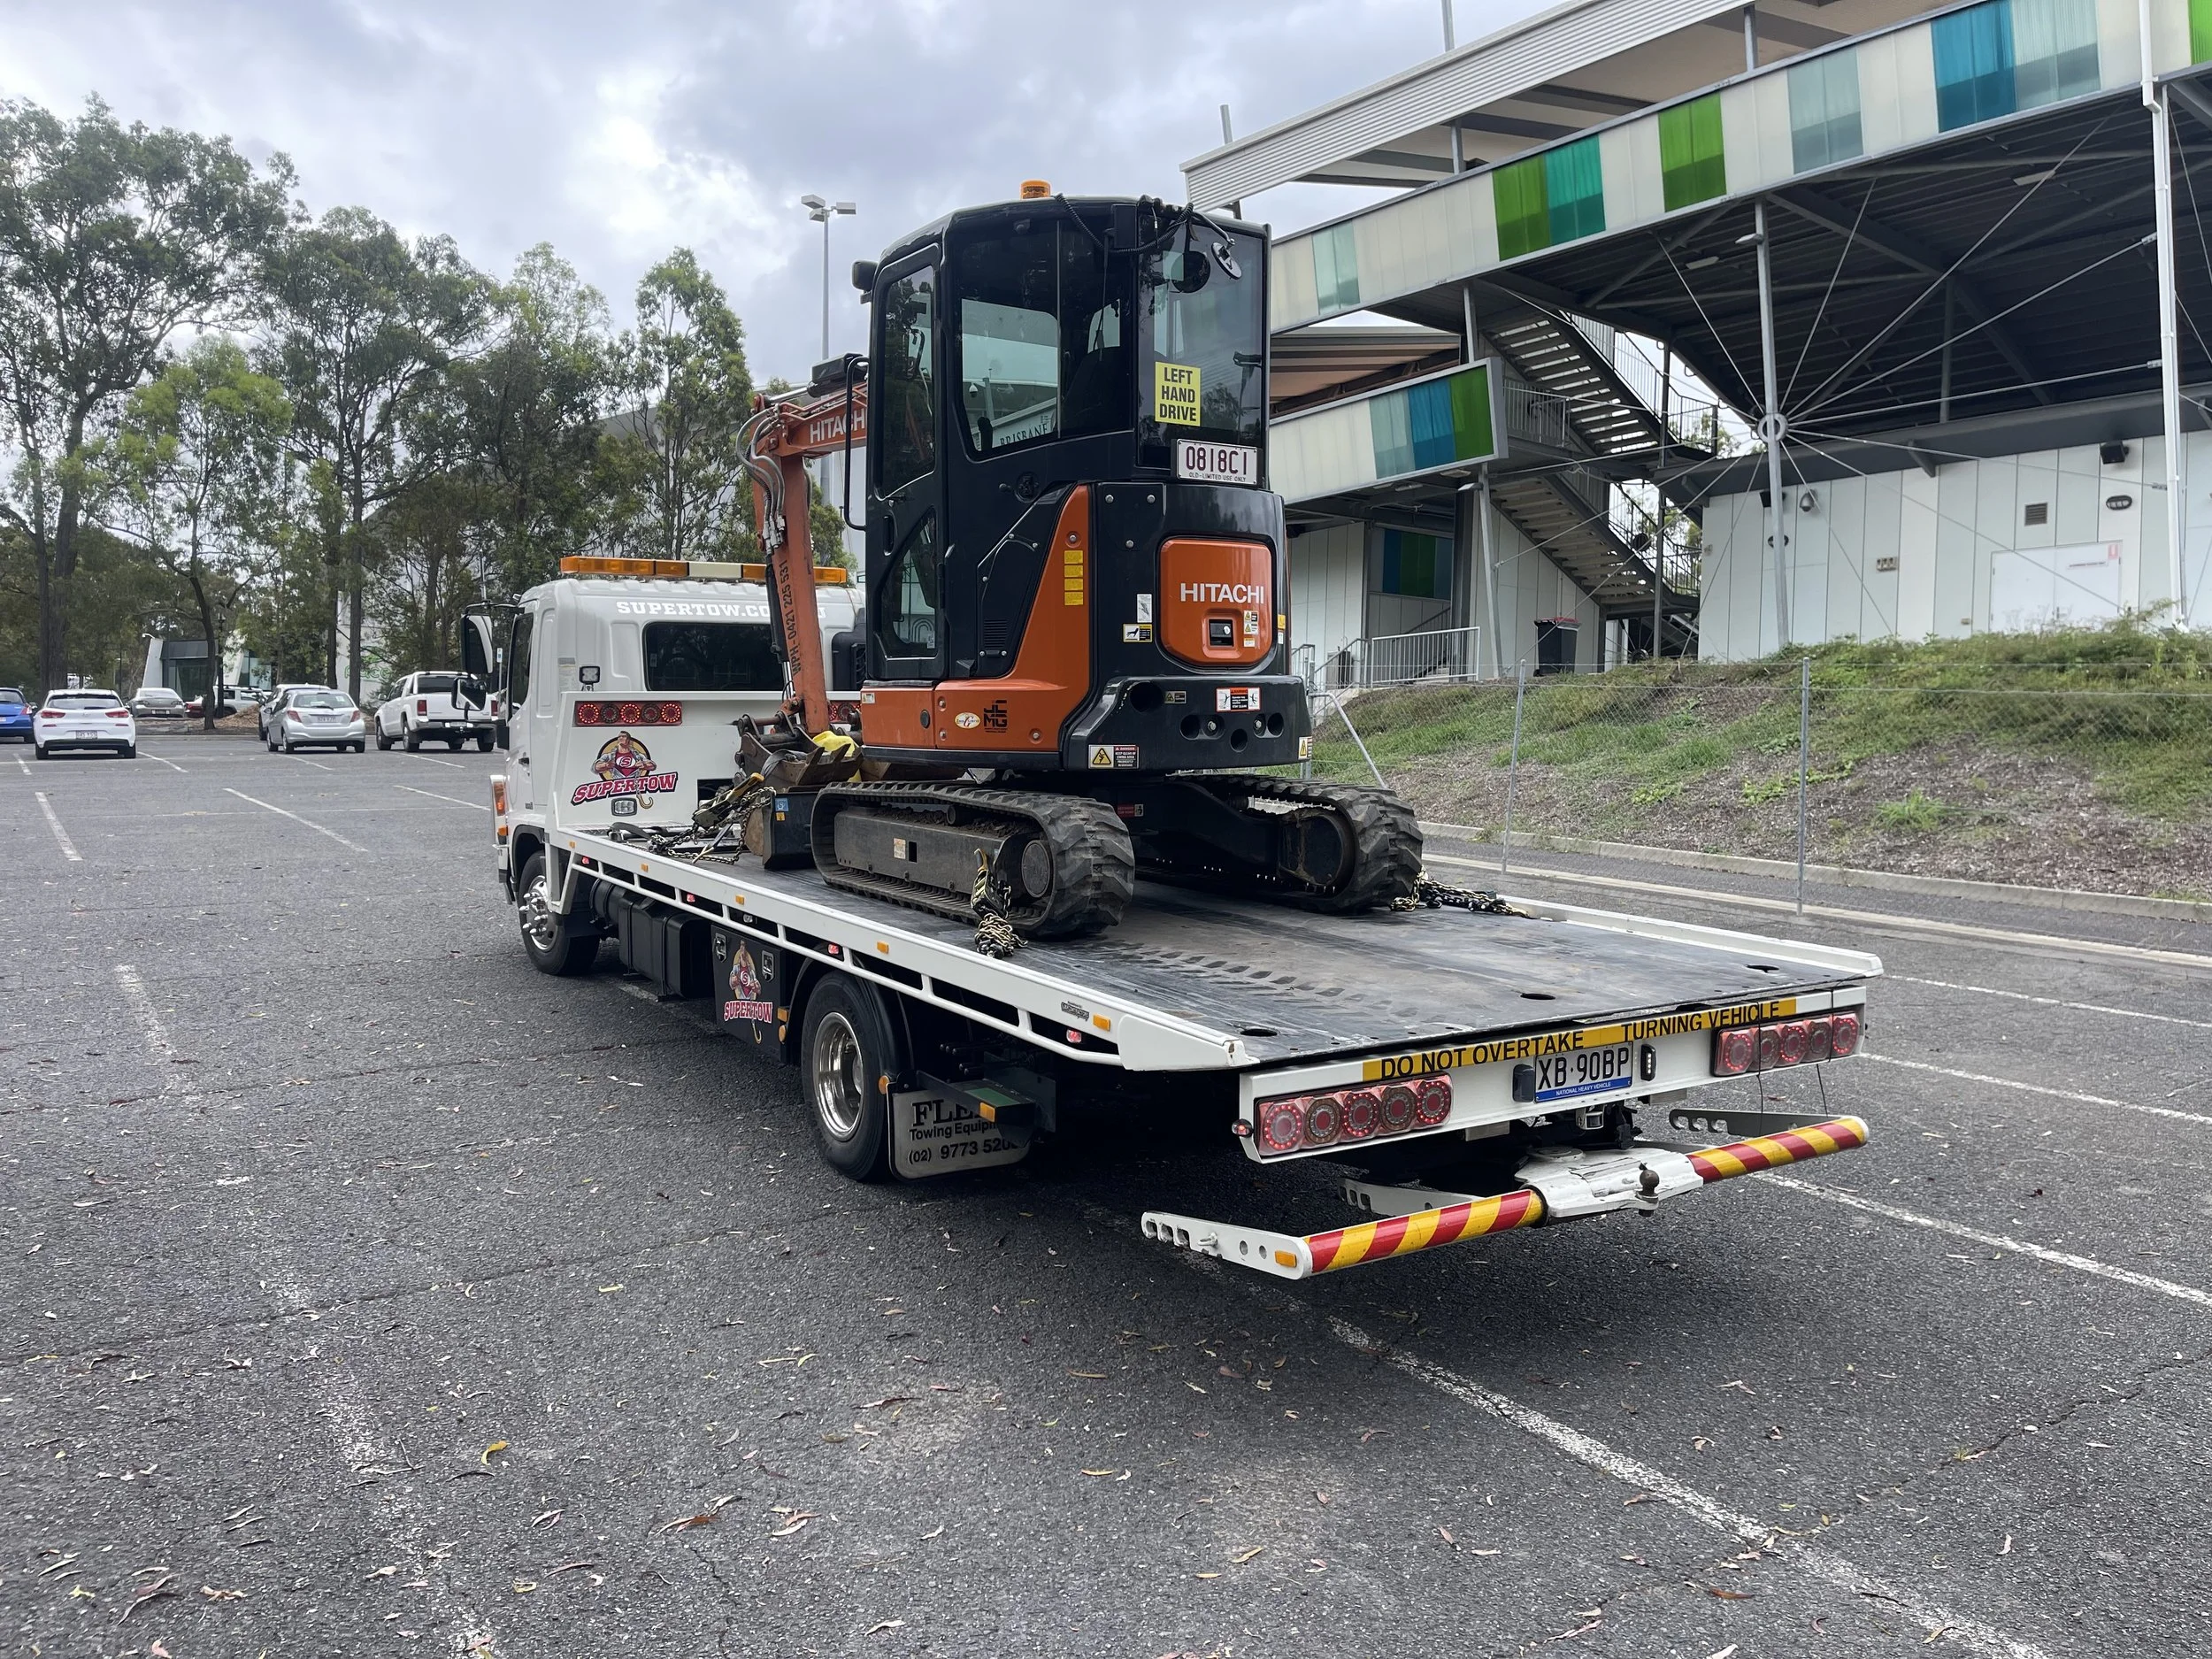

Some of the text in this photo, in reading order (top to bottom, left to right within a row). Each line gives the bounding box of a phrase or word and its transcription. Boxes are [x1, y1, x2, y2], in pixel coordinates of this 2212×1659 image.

[1164, 366, 1193, 384] LEFT
[1161, 385, 1195, 403] HAND
[1159, 403, 1197, 422] DRIVE
[810, 408, 867, 443] HITACH
[779, 559, 789, 584] 531
[781, 584, 793, 609] 225
[1180, 582, 1264, 604] HITACHI
[572, 772, 676, 803] SUPERTOW
[724, 1000, 773, 1024] SUPERTOW
[1380, 1001, 1780, 1079] DO NOT OVERTAKE TURNING VEHICLE
[1555, 1087, 1578, 1096] NATIONAL
[1594, 1081, 1611, 1090] VEHICLE
[909, 1125, 952, 1141] Towing
[908, 1147, 933, 1164] (02)
[940, 1141, 979, 1160] 9773
